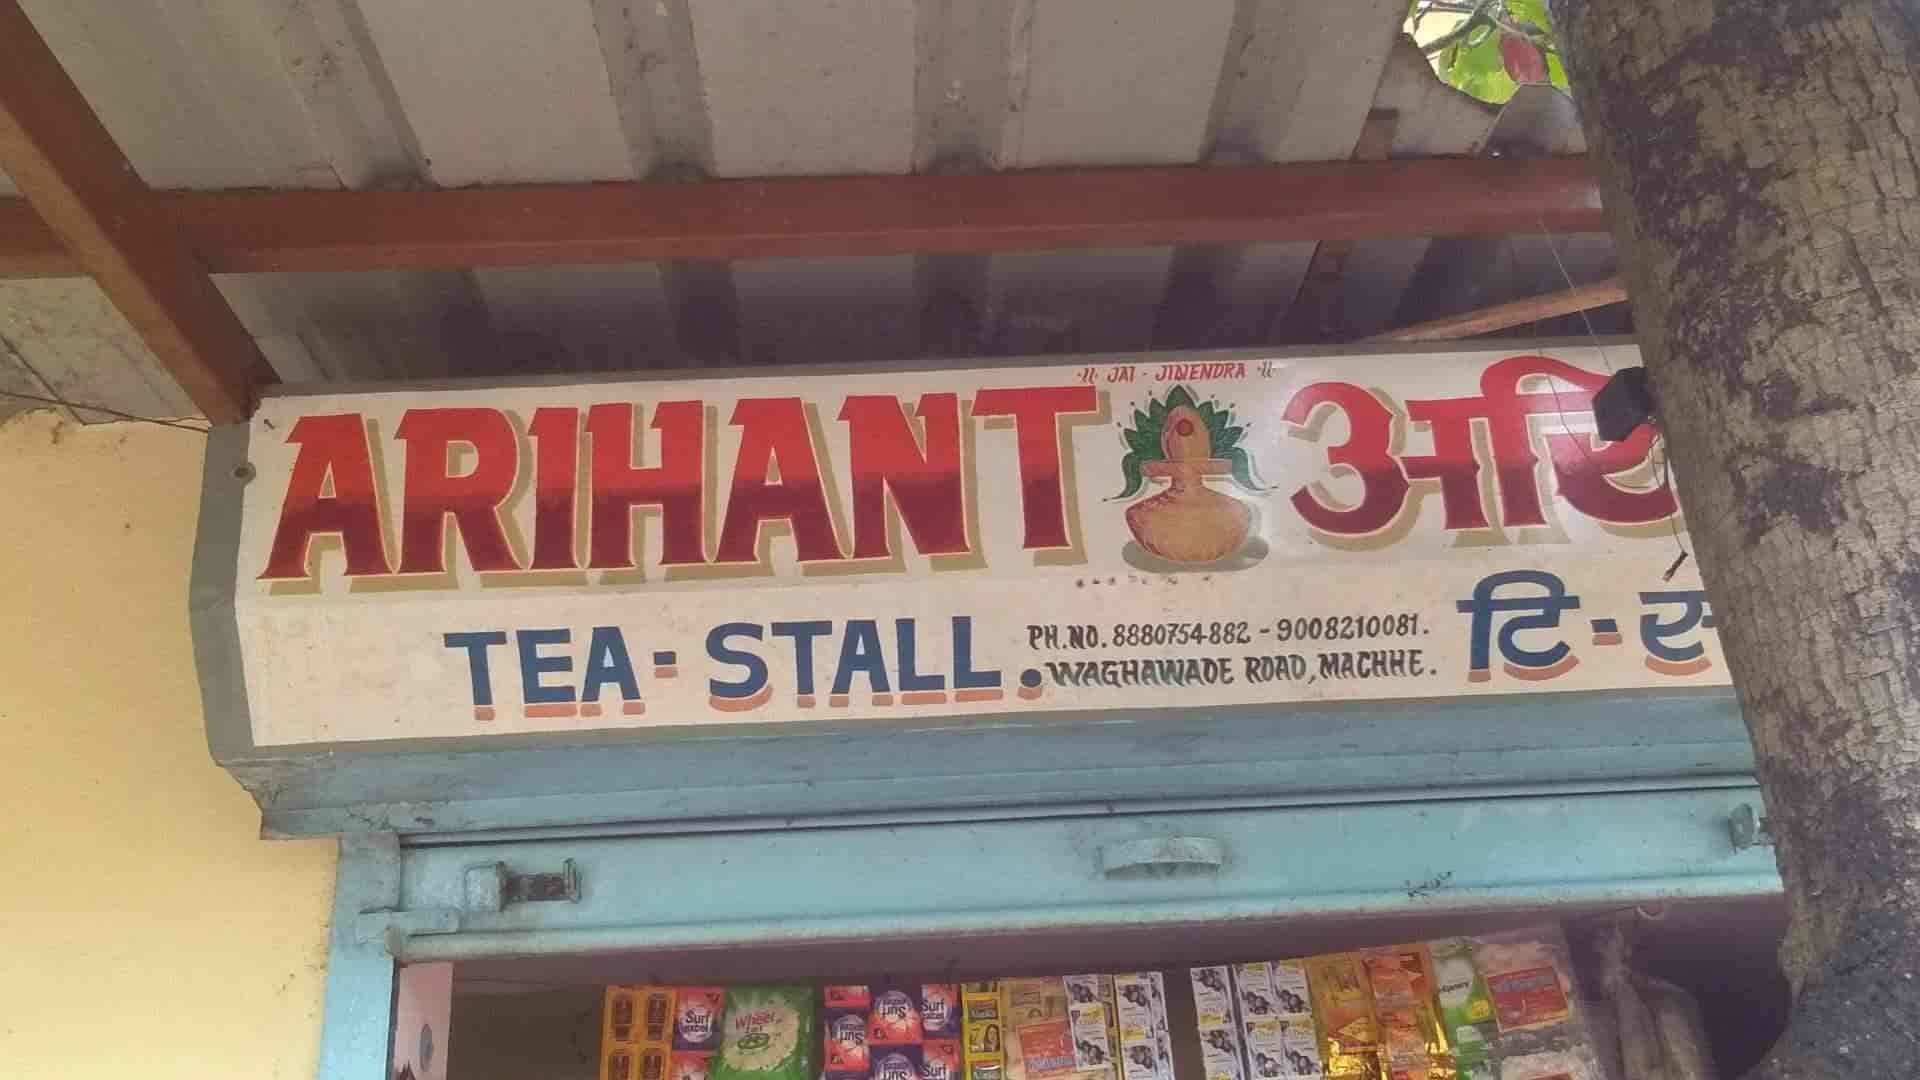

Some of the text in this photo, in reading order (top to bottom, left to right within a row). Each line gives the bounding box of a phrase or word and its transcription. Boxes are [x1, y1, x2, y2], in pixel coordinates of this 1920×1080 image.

[257, 386, 1098, 579] ARIHANT
[1044, 656, 1235, 688] WAGHAWADE
[685, 1009, 712, 1025] Surf
